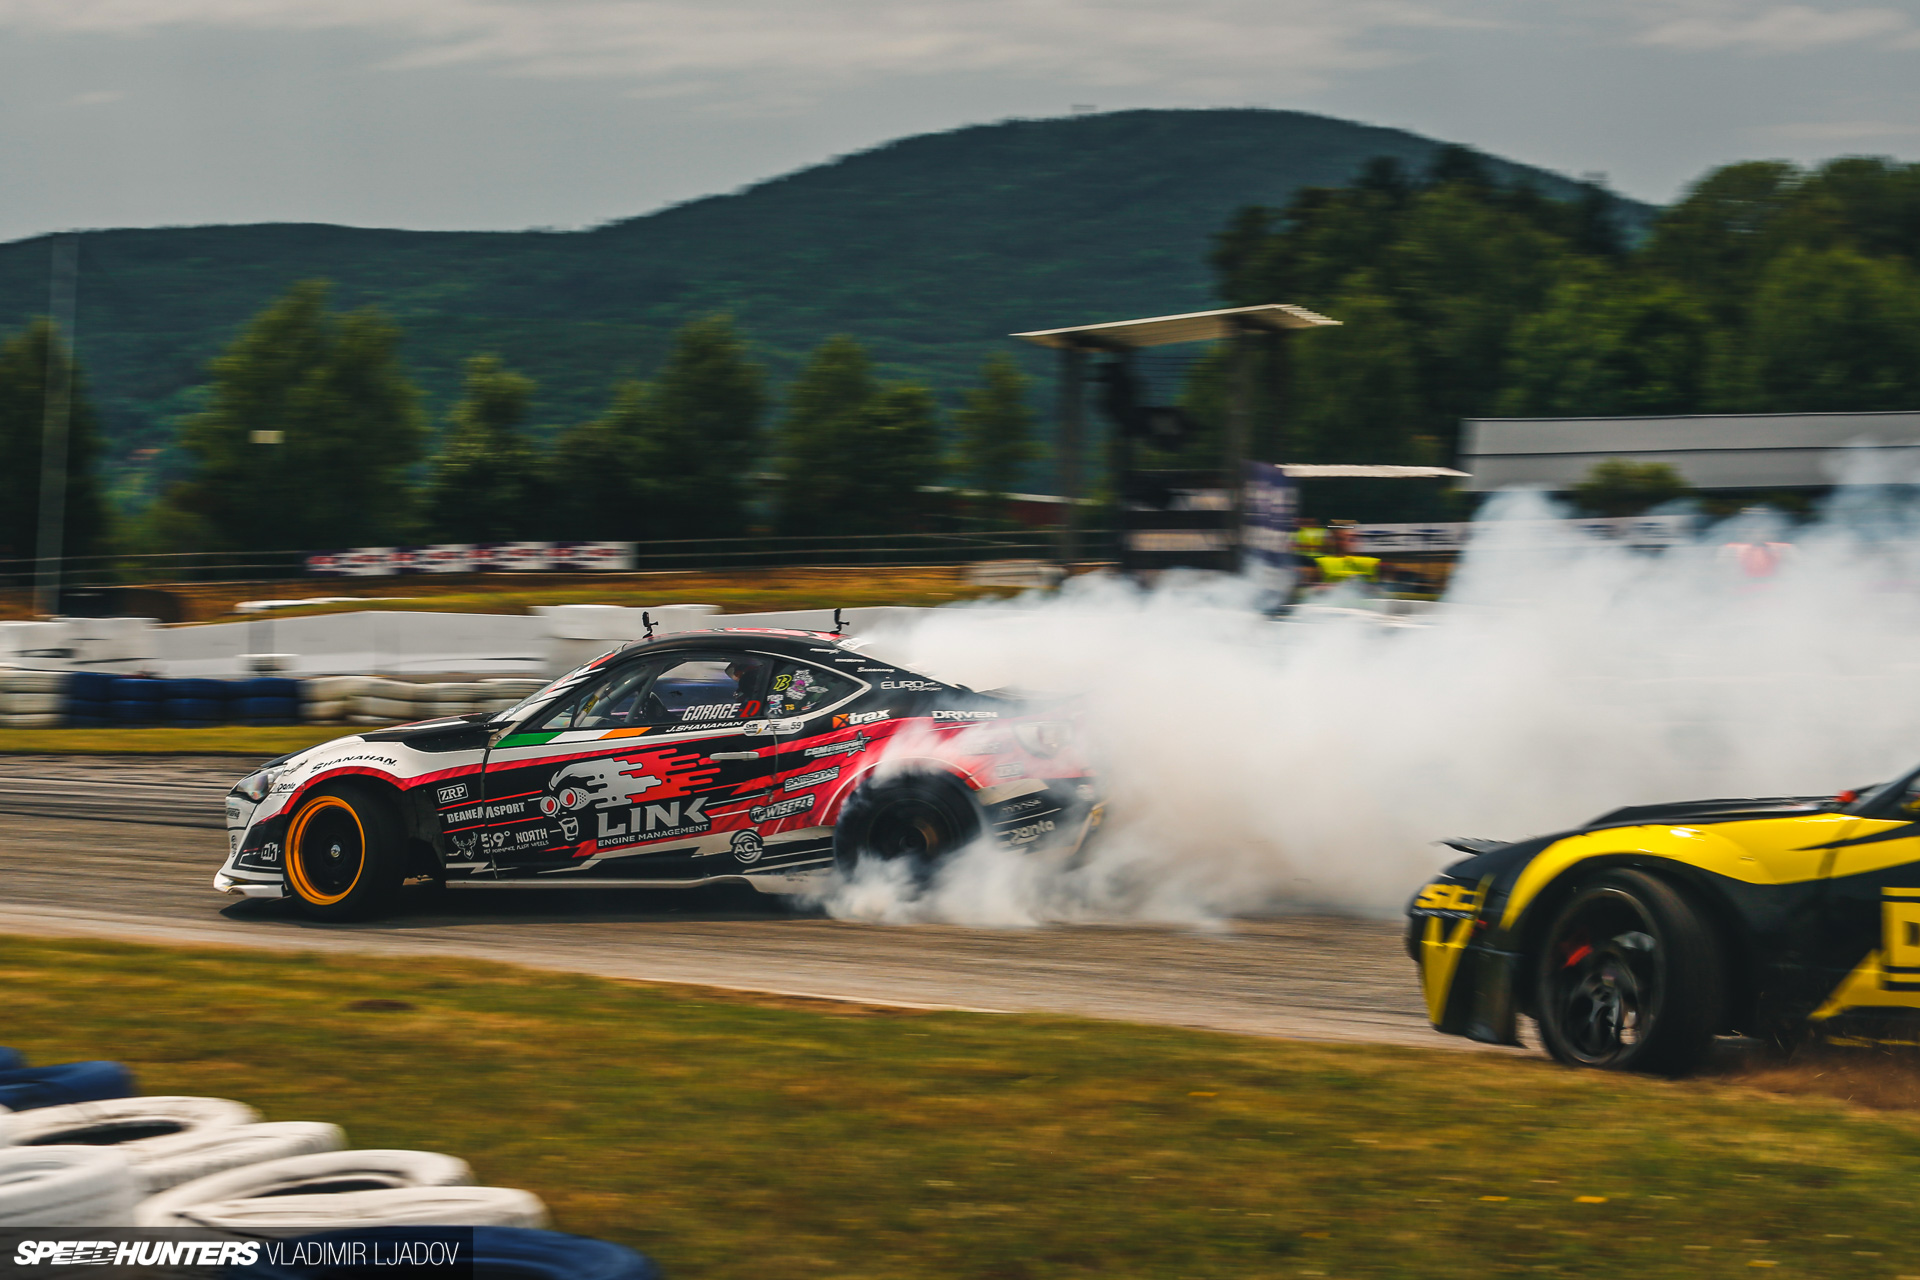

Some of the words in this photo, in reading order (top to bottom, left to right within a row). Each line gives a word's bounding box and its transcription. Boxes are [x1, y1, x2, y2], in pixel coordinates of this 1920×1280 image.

[880, 680, 924, 690] EURO
[931, 710, 999, 721] DRIVEN
[666, 721, 743, 733] J.SHANAHAN
[790, 721, 801, 730] 59
[440, 786, 466, 801] ZRP
[597, 797, 709, 838] LINK
[598, 835, 636, 847] ENGINE
[638, 824, 709, 841] MANAGEMENT
[734, 842, 763, 854] ACL
